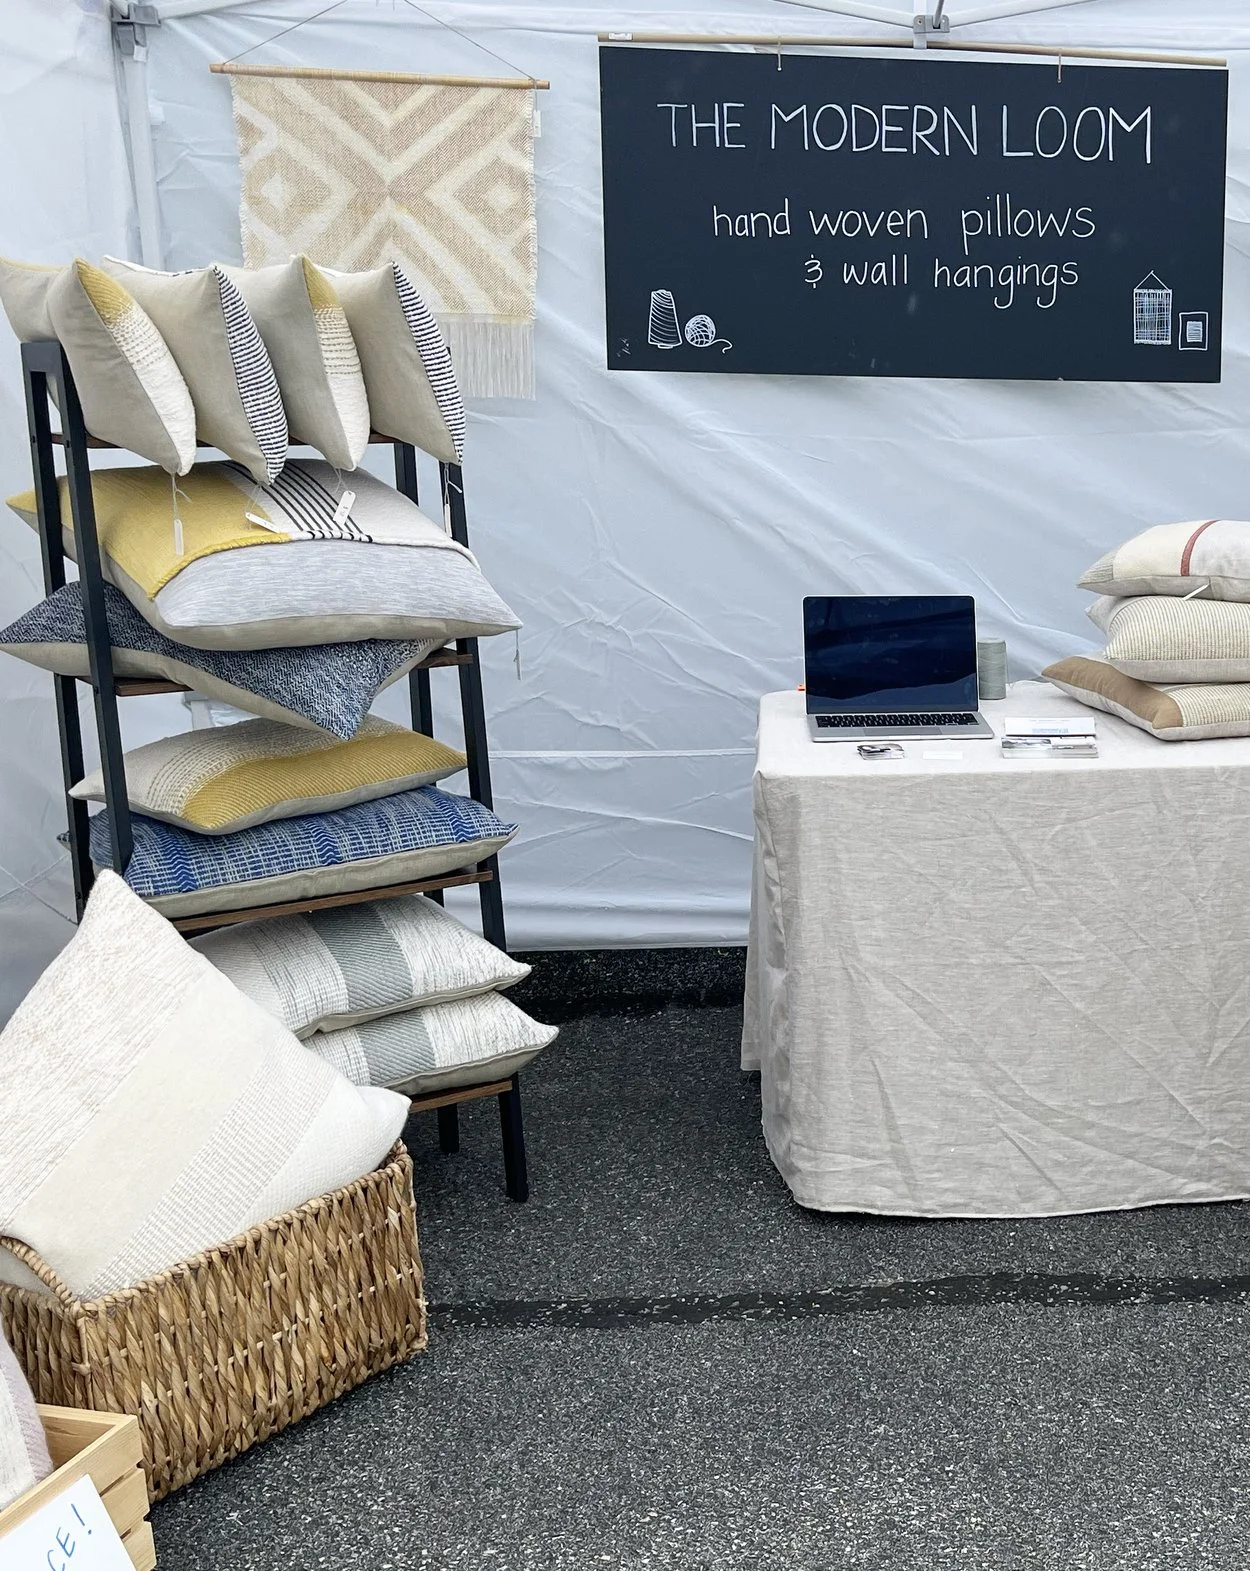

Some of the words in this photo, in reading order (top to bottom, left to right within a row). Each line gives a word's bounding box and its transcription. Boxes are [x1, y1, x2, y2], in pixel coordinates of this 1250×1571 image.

[657, 103, 745, 148] THE
[771, 103, 978, 156] MODERN
[1003, 105, 1152, 164] LOOM
[713, 198, 791, 237] hand
[809, 209, 928, 239] woven
[962, 193, 1096, 255] pillows
[804, 254, 823, 289] &
[843, 254, 908, 285] wall
[934, 256, 1079, 309] hangings
